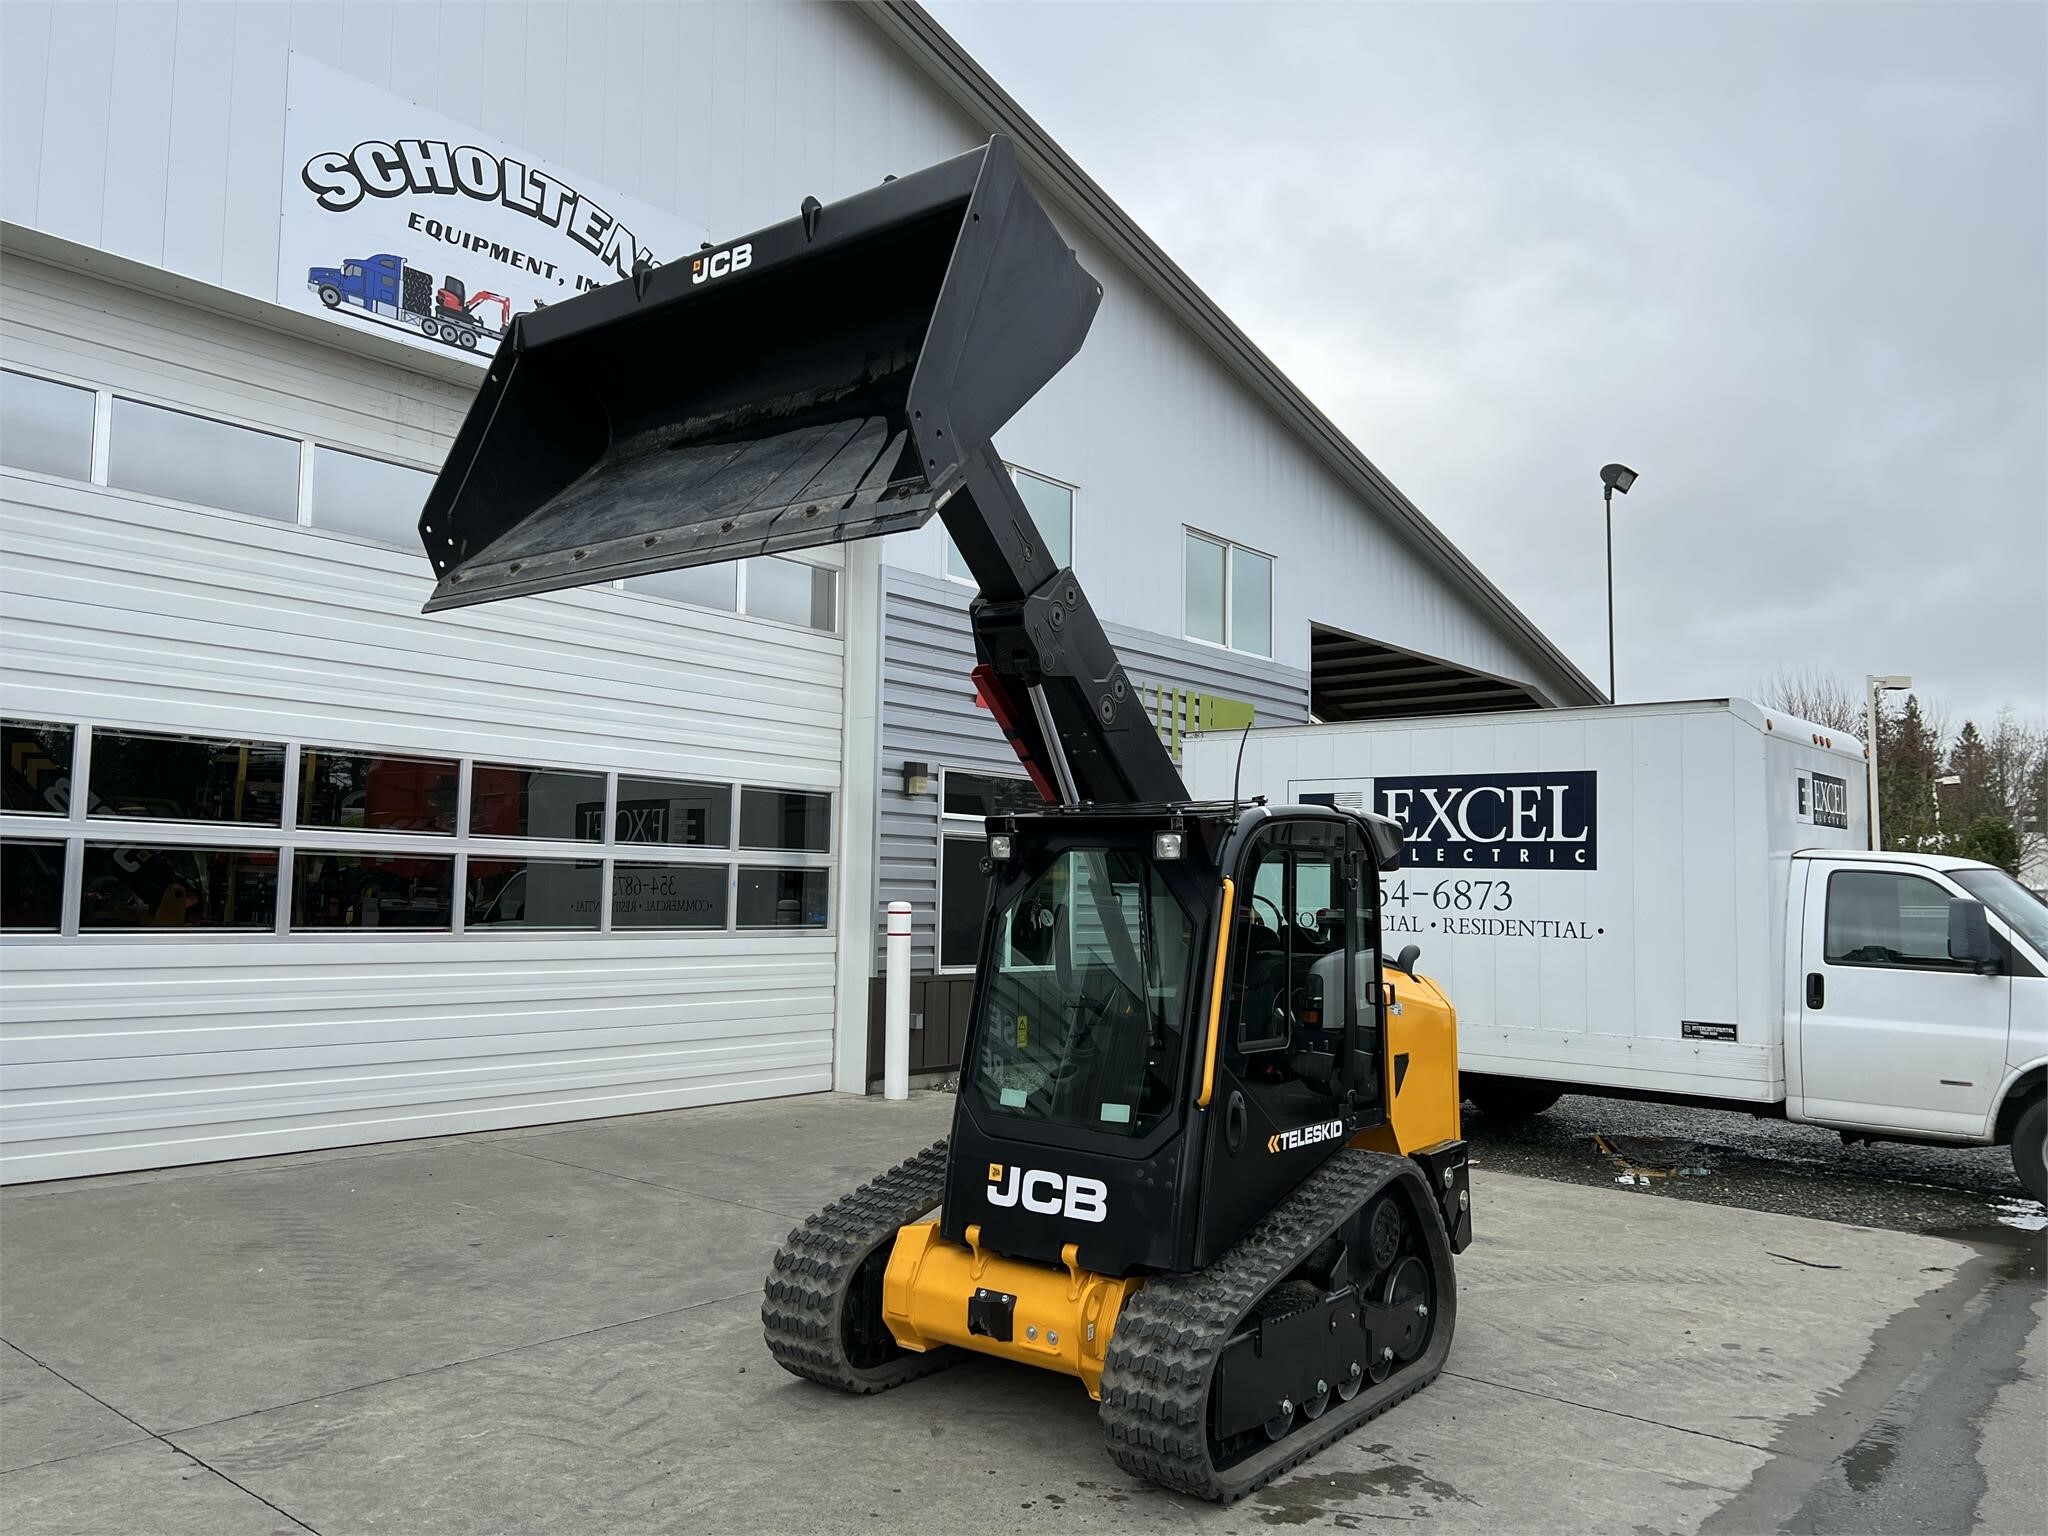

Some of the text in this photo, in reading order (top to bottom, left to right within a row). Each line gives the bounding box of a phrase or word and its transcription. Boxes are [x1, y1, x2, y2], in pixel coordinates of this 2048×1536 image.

[301, 139, 664, 280] SCHOLTEN
[692, 242, 753, 285] JCB
[1381, 785, 1589, 844] EXCEL
[1813, 779, 1846, 815] EXCEL
[1411, 847, 1587, 864] LECTRIC
[1379, 878, 1514, 912] 54-6873
[1442, 917, 1594, 941] RESIDENTIAL
[1280, 1119, 1343, 1151] TELESKID
[986, 1165, 1108, 1223] JCB
